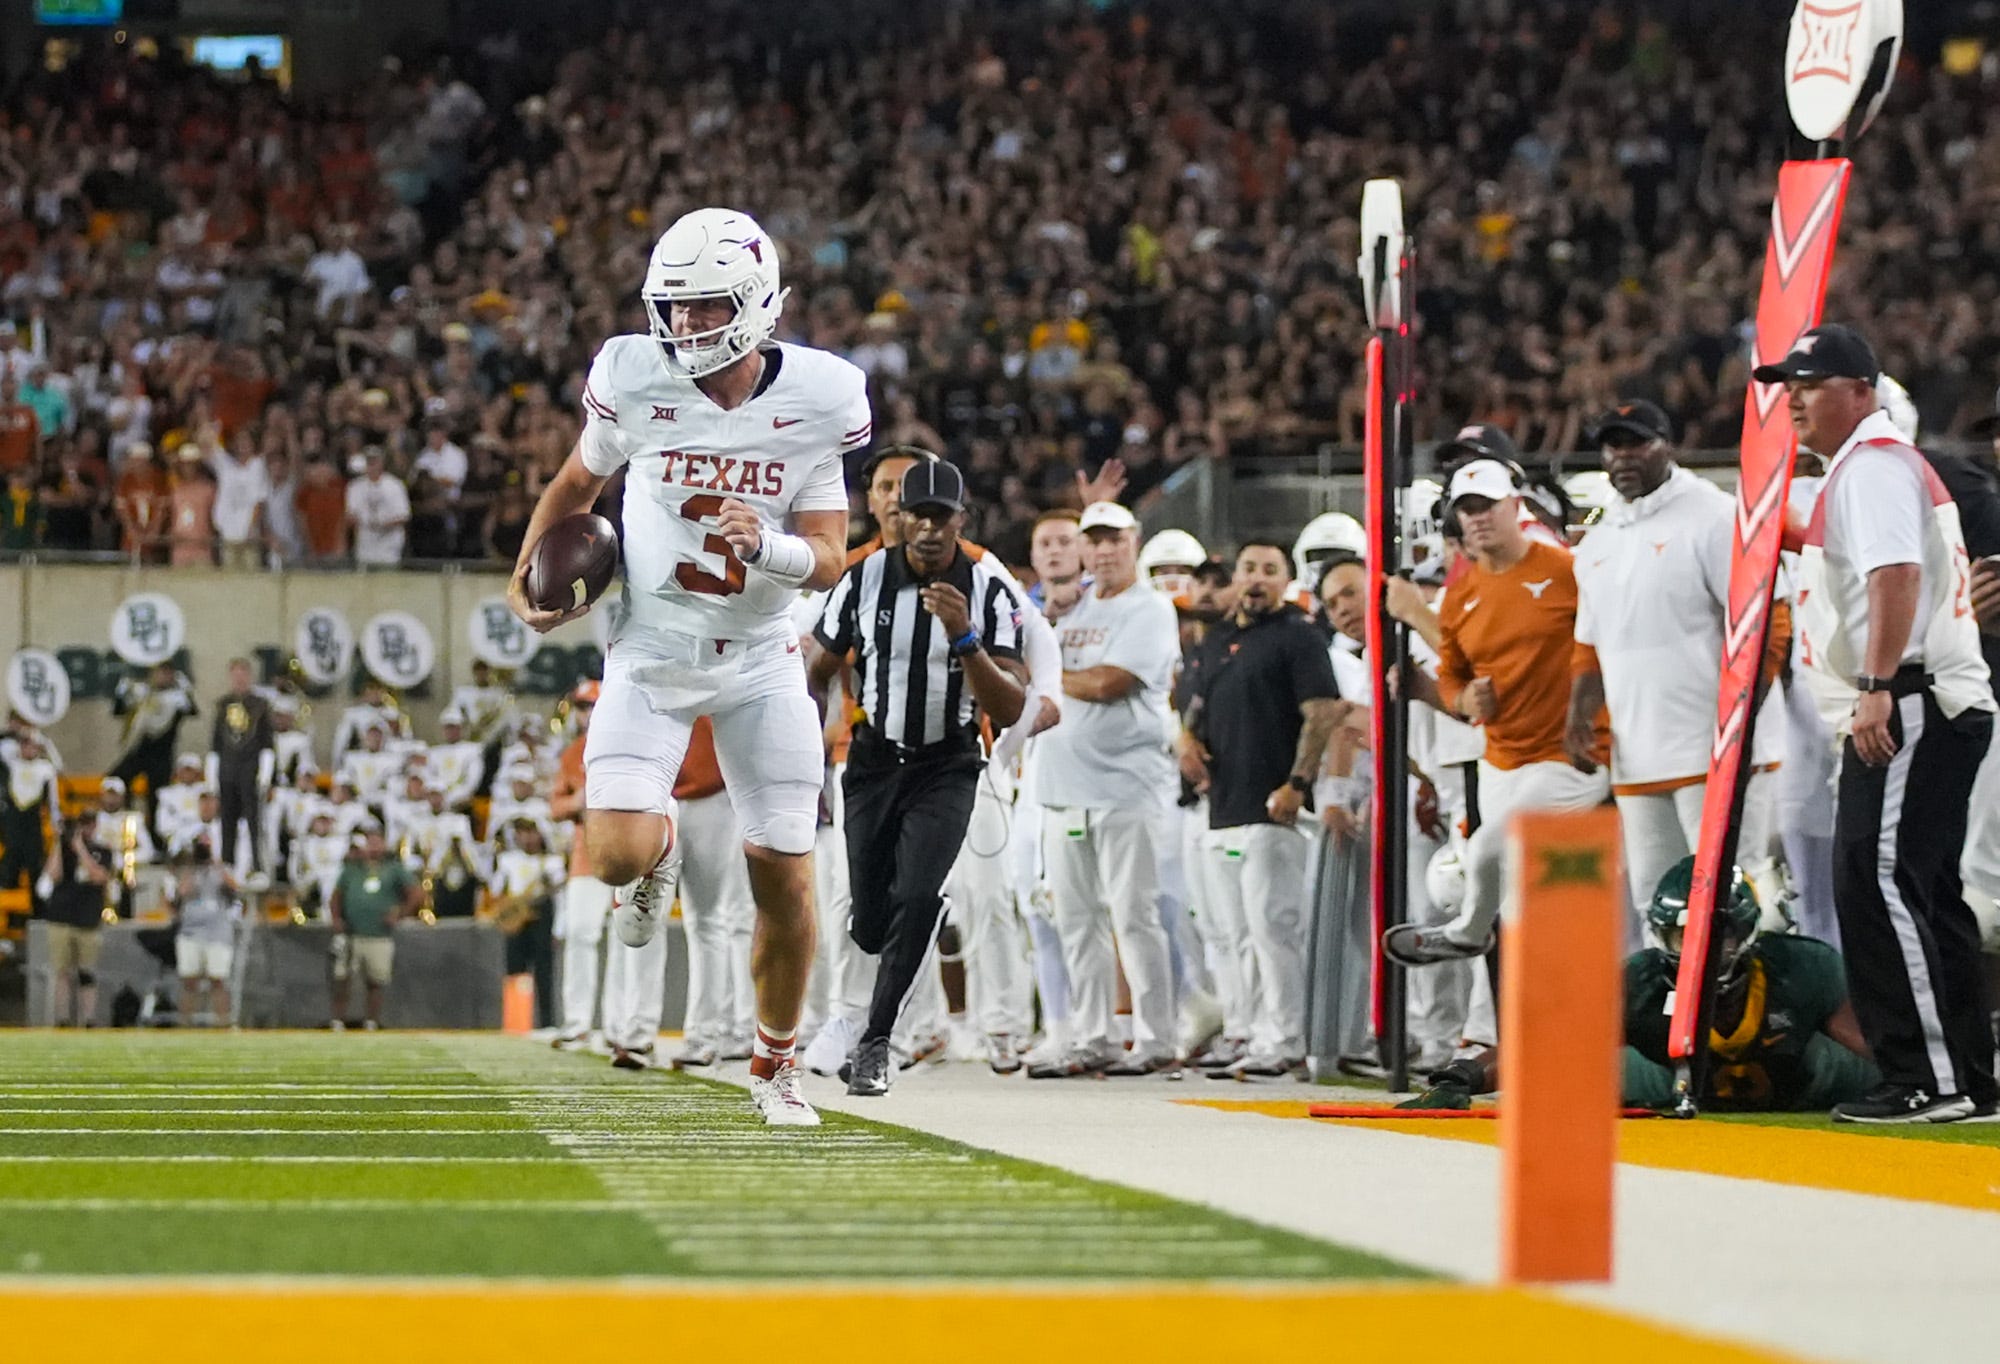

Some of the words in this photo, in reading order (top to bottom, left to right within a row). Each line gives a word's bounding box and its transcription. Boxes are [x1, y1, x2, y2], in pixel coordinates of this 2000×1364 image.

[660, 450, 785, 496] TEXAS
[674, 493, 747, 596] 3
[878, 610, 892, 626] S
